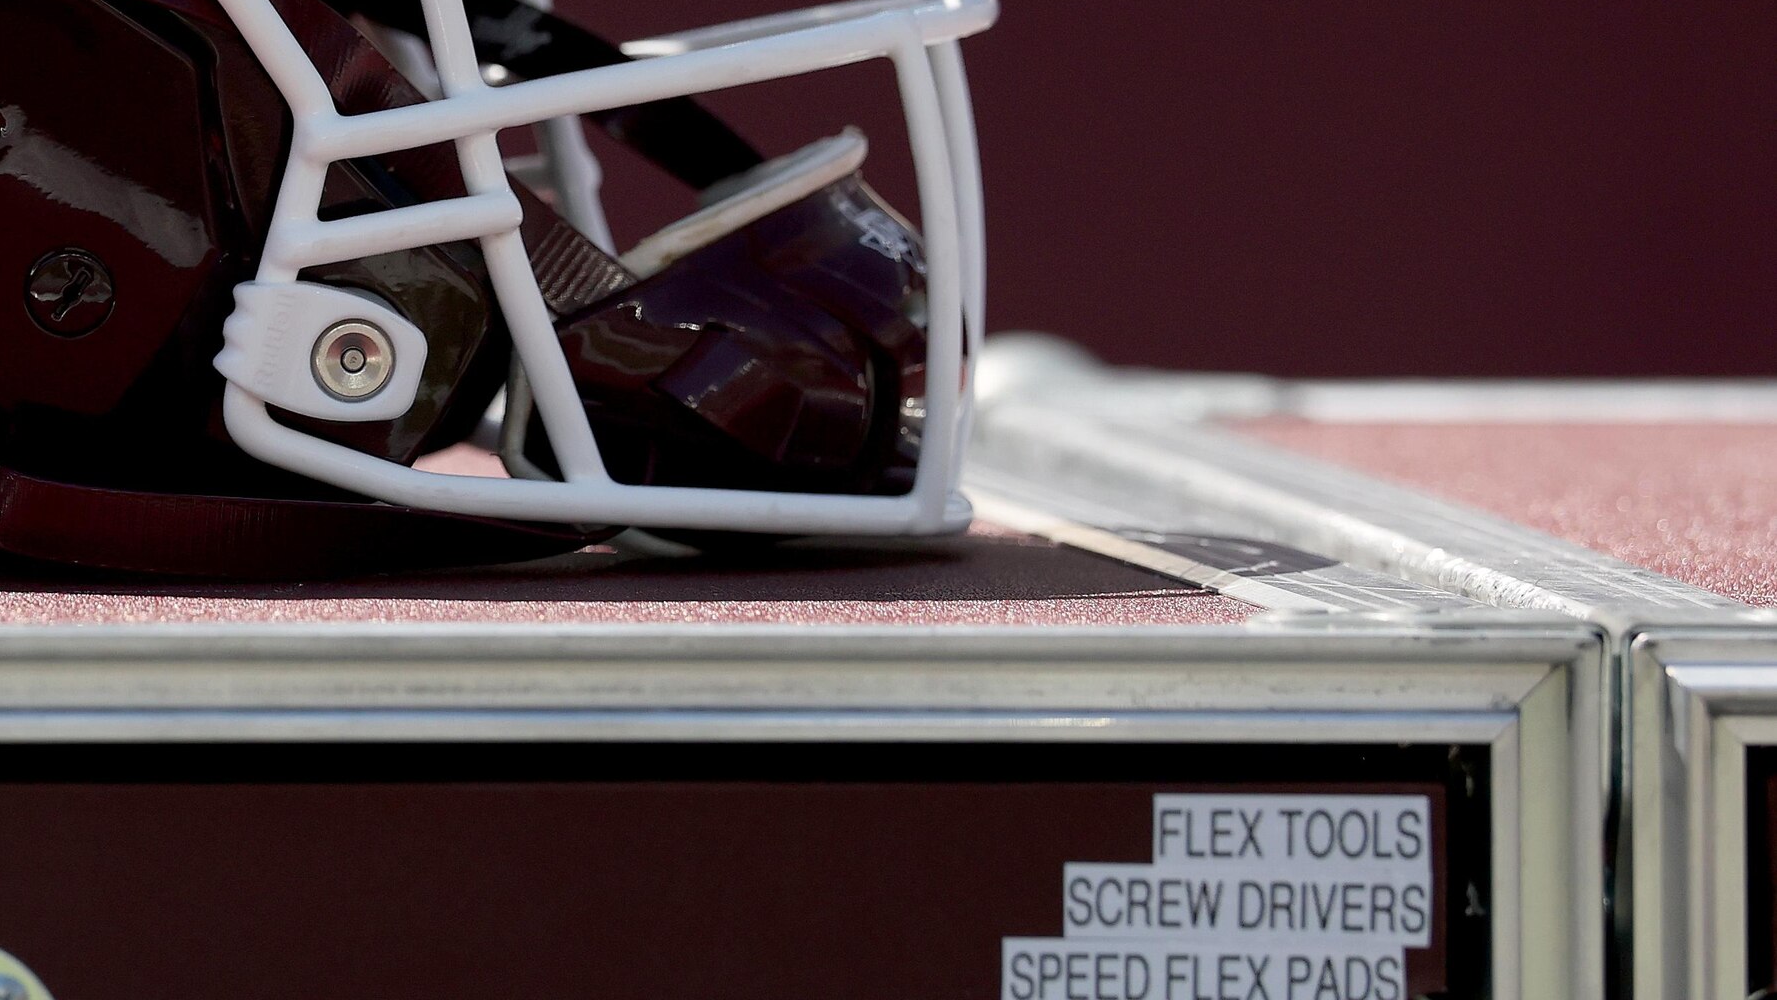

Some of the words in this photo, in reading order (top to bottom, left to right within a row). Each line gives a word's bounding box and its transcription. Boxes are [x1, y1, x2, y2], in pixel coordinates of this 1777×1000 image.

[1156, 807, 1265, 858] FLEX
[1278, 808, 1423, 860] TOOLS
[1067, 876, 1225, 928] SCREW
[1236, 880, 1428, 934] DRIVERS
[1008, 952, 1152, 1000] SPEED
[1165, 953, 1272, 1000] FLEX
[1286, 955, 1402, 1000] PADS
